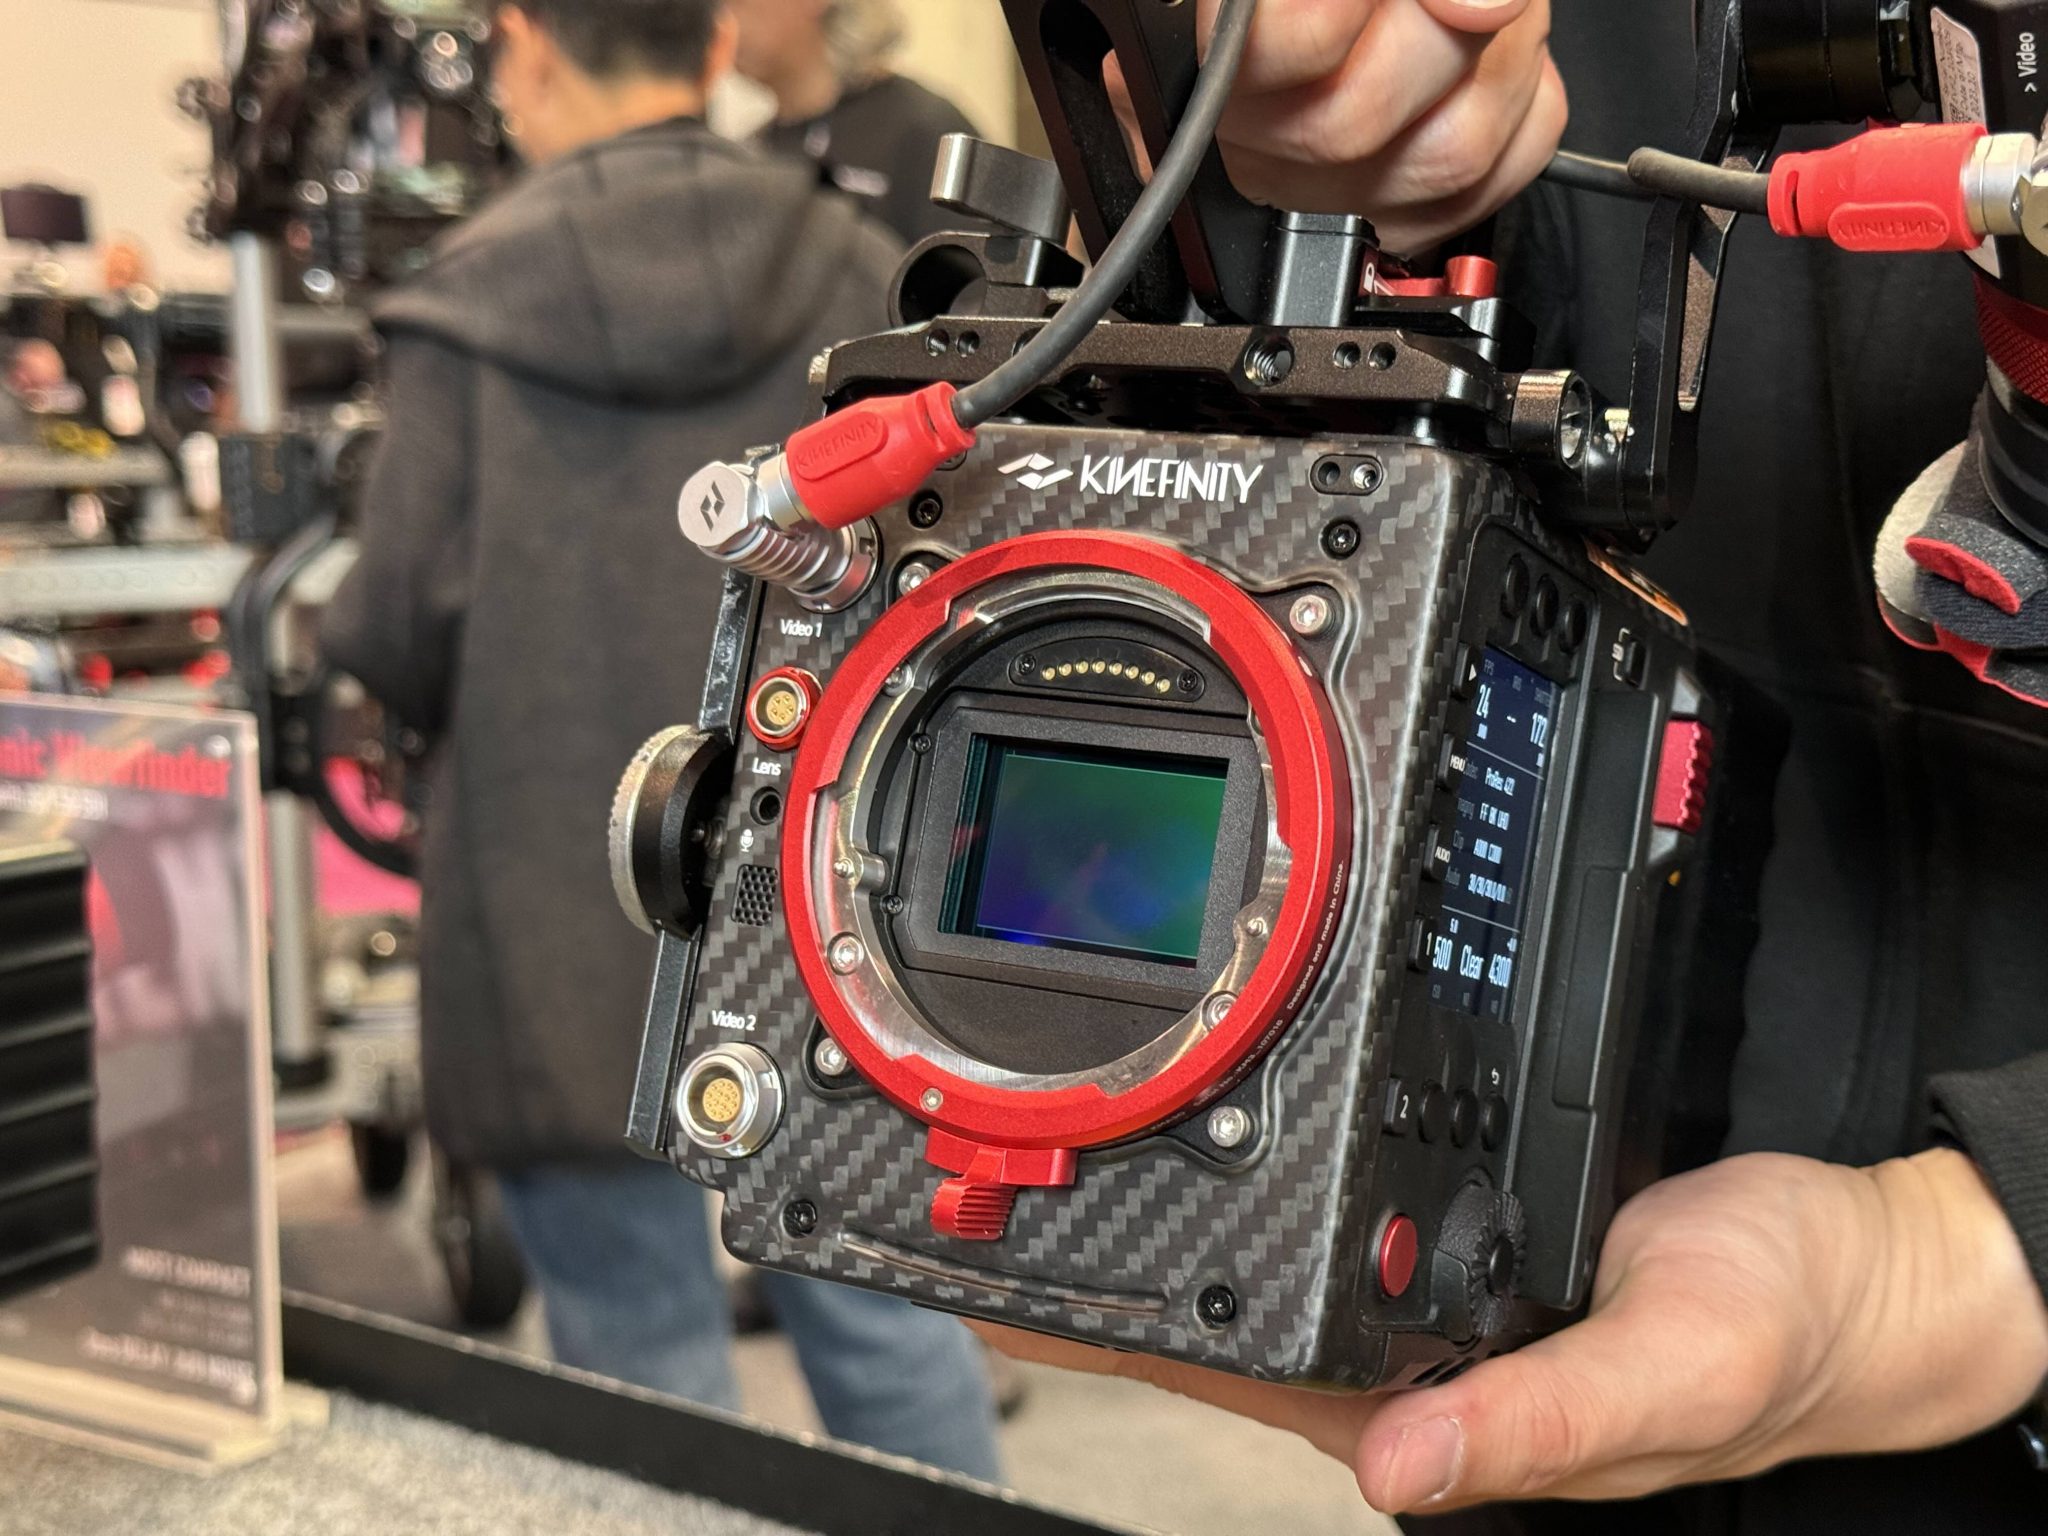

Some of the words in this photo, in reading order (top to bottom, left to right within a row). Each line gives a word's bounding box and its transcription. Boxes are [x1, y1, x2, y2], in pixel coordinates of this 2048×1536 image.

[2016, 32, 2038, 78] Video
[796, 416, 878, 468] KINEFINITY
[1080, 454, 1264, 503] KINEFINITY
[780, 618, 813, 637] Video
[815, 622, 823, 638] 1
[1476, 684, 1491, 719] 24
[752, 757, 782, 776] Lens
[1450, 754, 1466, 772] MENU
[1434, 845, 1451, 864] AUDIO
[1286, 965, 1314, 1010] Designed
[1312, 943, 1323, 963] and
[1321, 912, 1334, 942] made
[1432, 935, 1453, 971] 500
[1460, 944, 1486, 980] Clear
[1487, 953, 1513, 988] 4300
[711, 1010, 746, 1029] Video
[745, 1014, 757, 1032] 2
[1400, 1094, 1409, 1118] 2
